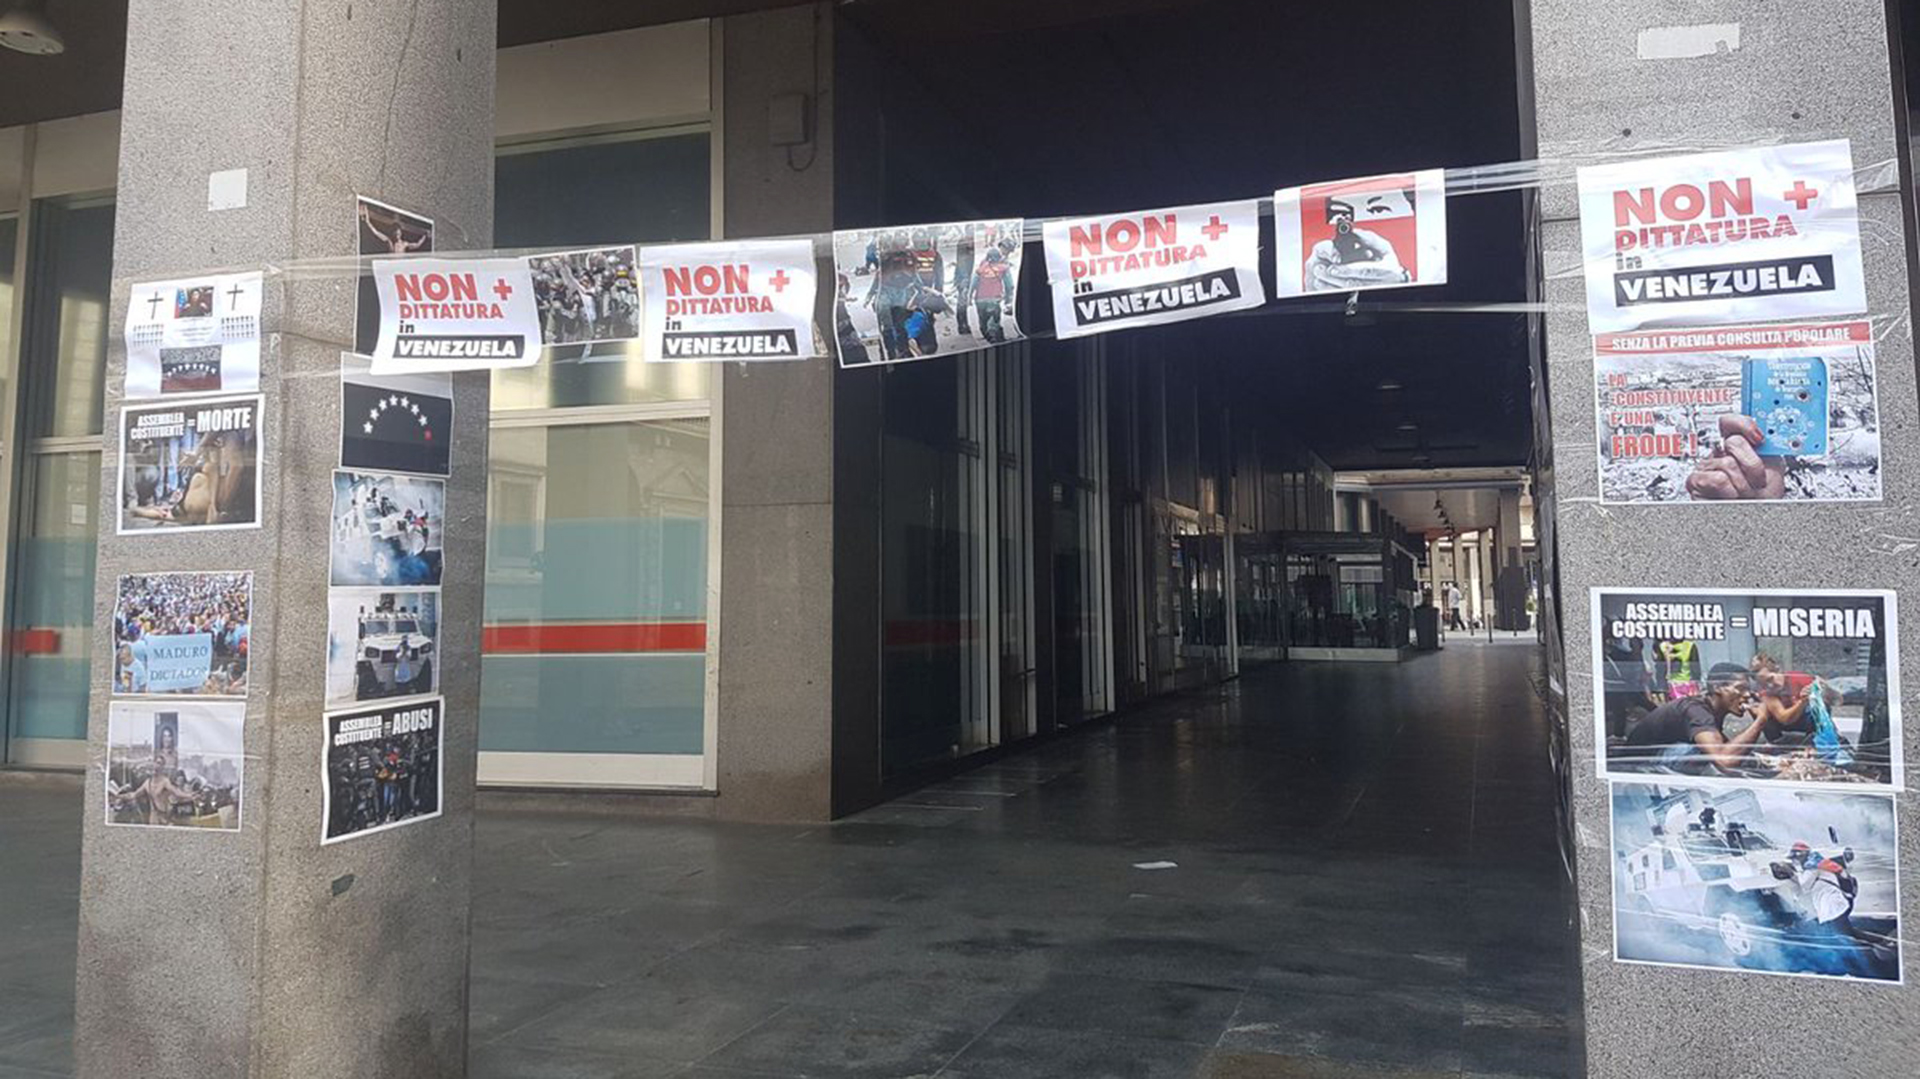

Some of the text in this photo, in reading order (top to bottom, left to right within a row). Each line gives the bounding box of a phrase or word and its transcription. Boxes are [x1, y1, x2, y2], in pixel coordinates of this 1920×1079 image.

[1613, 177, 1754, 228] NON
[1069, 214, 1177, 258] NON
[1614, 214, 1798, 252] DITTATURA
[1070, 244, 1208, 278] DITTATURA
[1616, 252, 1643, 271] in
[394, 273, 478, 301] NON
[663, 265, 749, 296] NON
[1074, 279, 1093, 294] in
[1619, 263, 1824, 301] VENEZUELA
[666, 296, 774, 315] DITTATURA
[1077, 277, 1231, 320] VENEZUELA
[399, 303, 504, 319] DITTATURA
[399, 320, 415, 333] in
[665, 316, 682, 330] in
[398, 340, 517, 357] VENEZUELA
[665, 335, 791, 355] VENEZUELA
[1612, 327, 1851, 351] SENZA LA PREVIA CONSULTA POPOLARE
[196, 407, 251, 432] MORTE
[1612, 434, 1683, 457] FRODE
[1625, 603, 1724, 622] ASSEMBLEA
[1753, 607, 1876, 639] MISERIA
[1612, 620, 1725, 640] COSTITUENTE
[153, 645, 209, 659] MADURO
[392, 708, 433, 735] ABUSI
